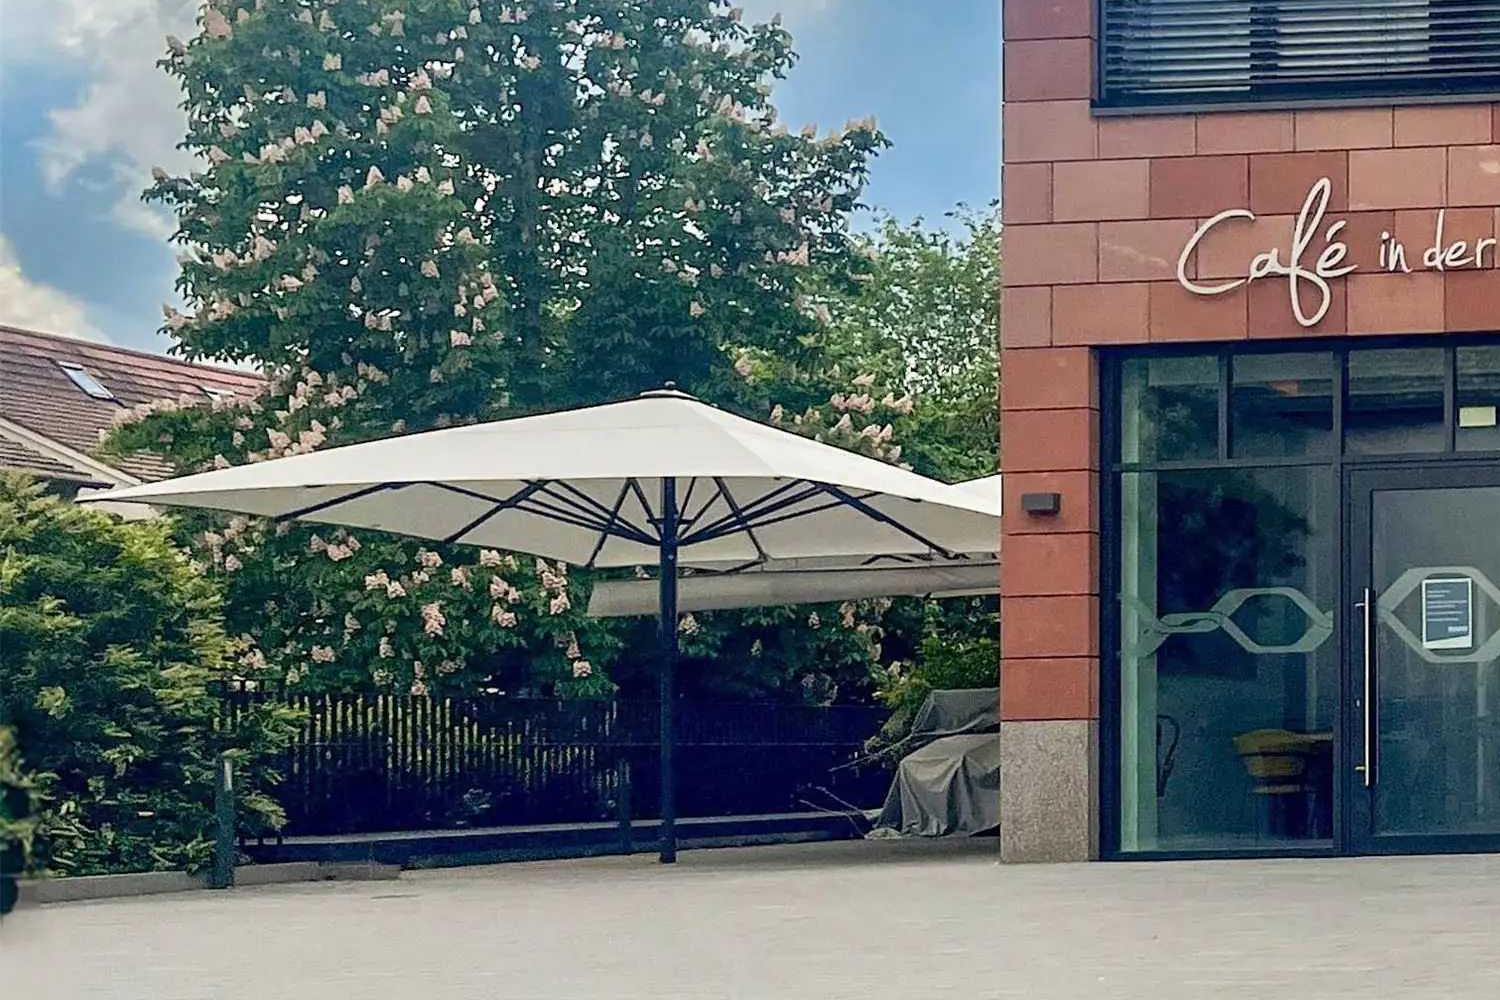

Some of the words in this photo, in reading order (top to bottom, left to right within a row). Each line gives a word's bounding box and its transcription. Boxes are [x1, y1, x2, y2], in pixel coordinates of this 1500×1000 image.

[1177, 177, 1358, 327] Café
[1379, 231, 1413, 273] in
[1423, 208, 1497, 271] der
